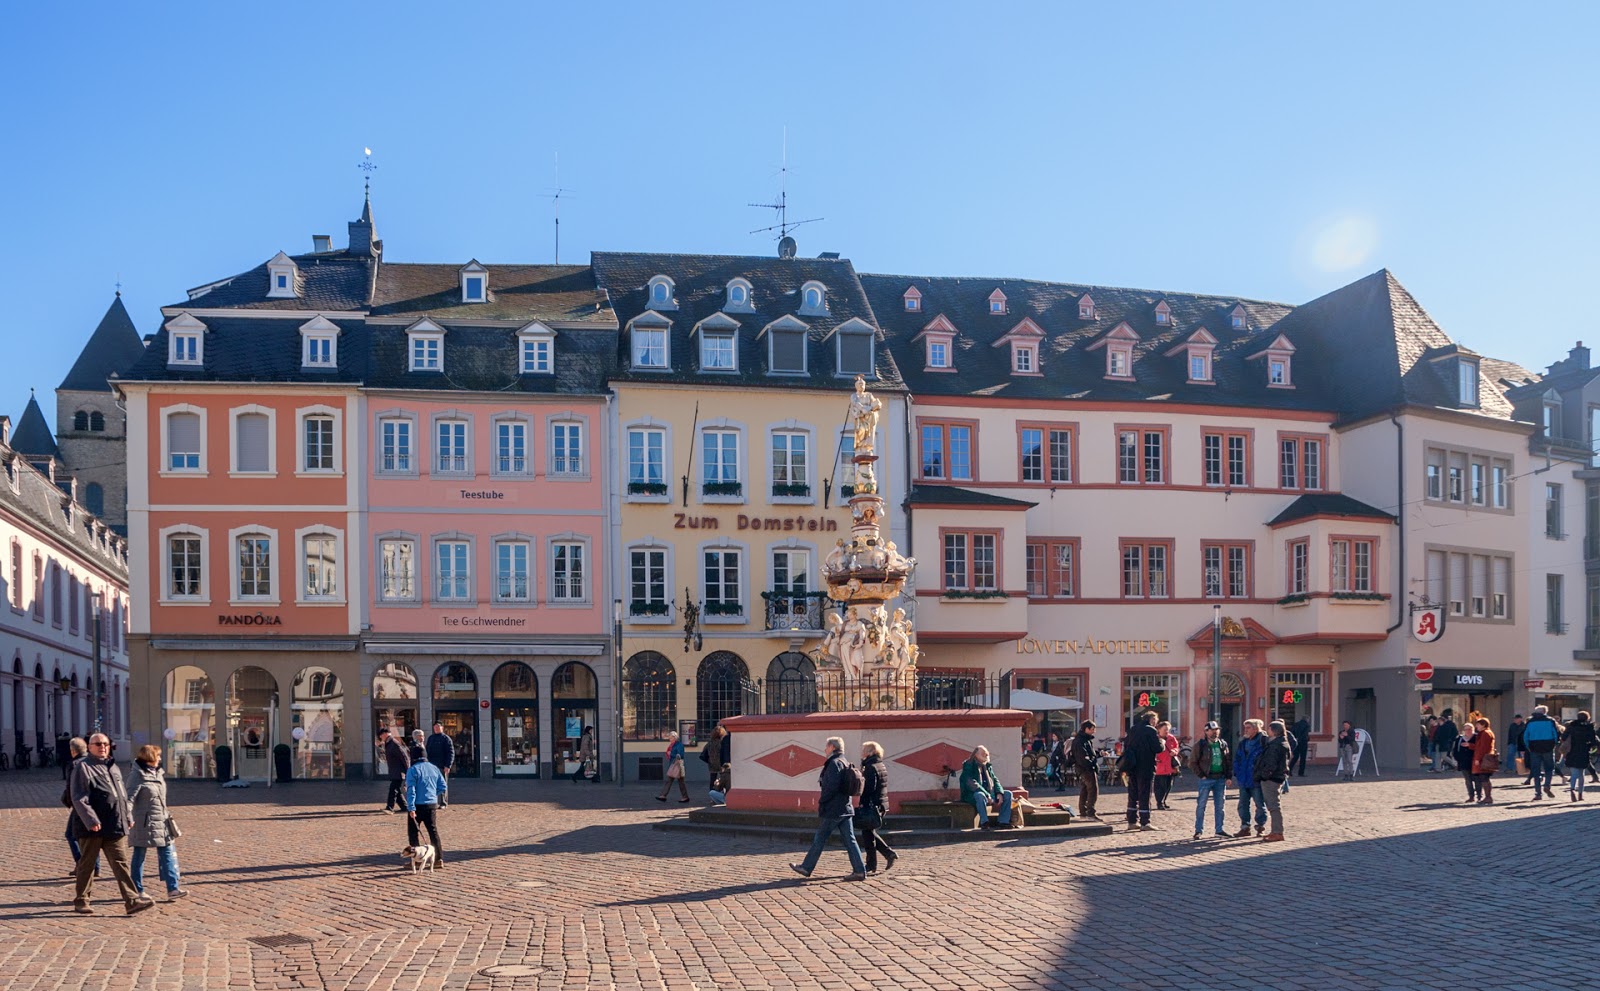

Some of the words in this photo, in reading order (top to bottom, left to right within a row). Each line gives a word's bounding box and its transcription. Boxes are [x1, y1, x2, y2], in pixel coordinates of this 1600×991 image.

[460, 490, 504, 499] Teestube
[673, 512, 719, 530] Zum
[736, 514, 838, 532] Domstein
[218, 614, 282, 626] PANDORA
[442, 616, 459, 626] Tee
[461, 616, 526, 626] Gschwendner
